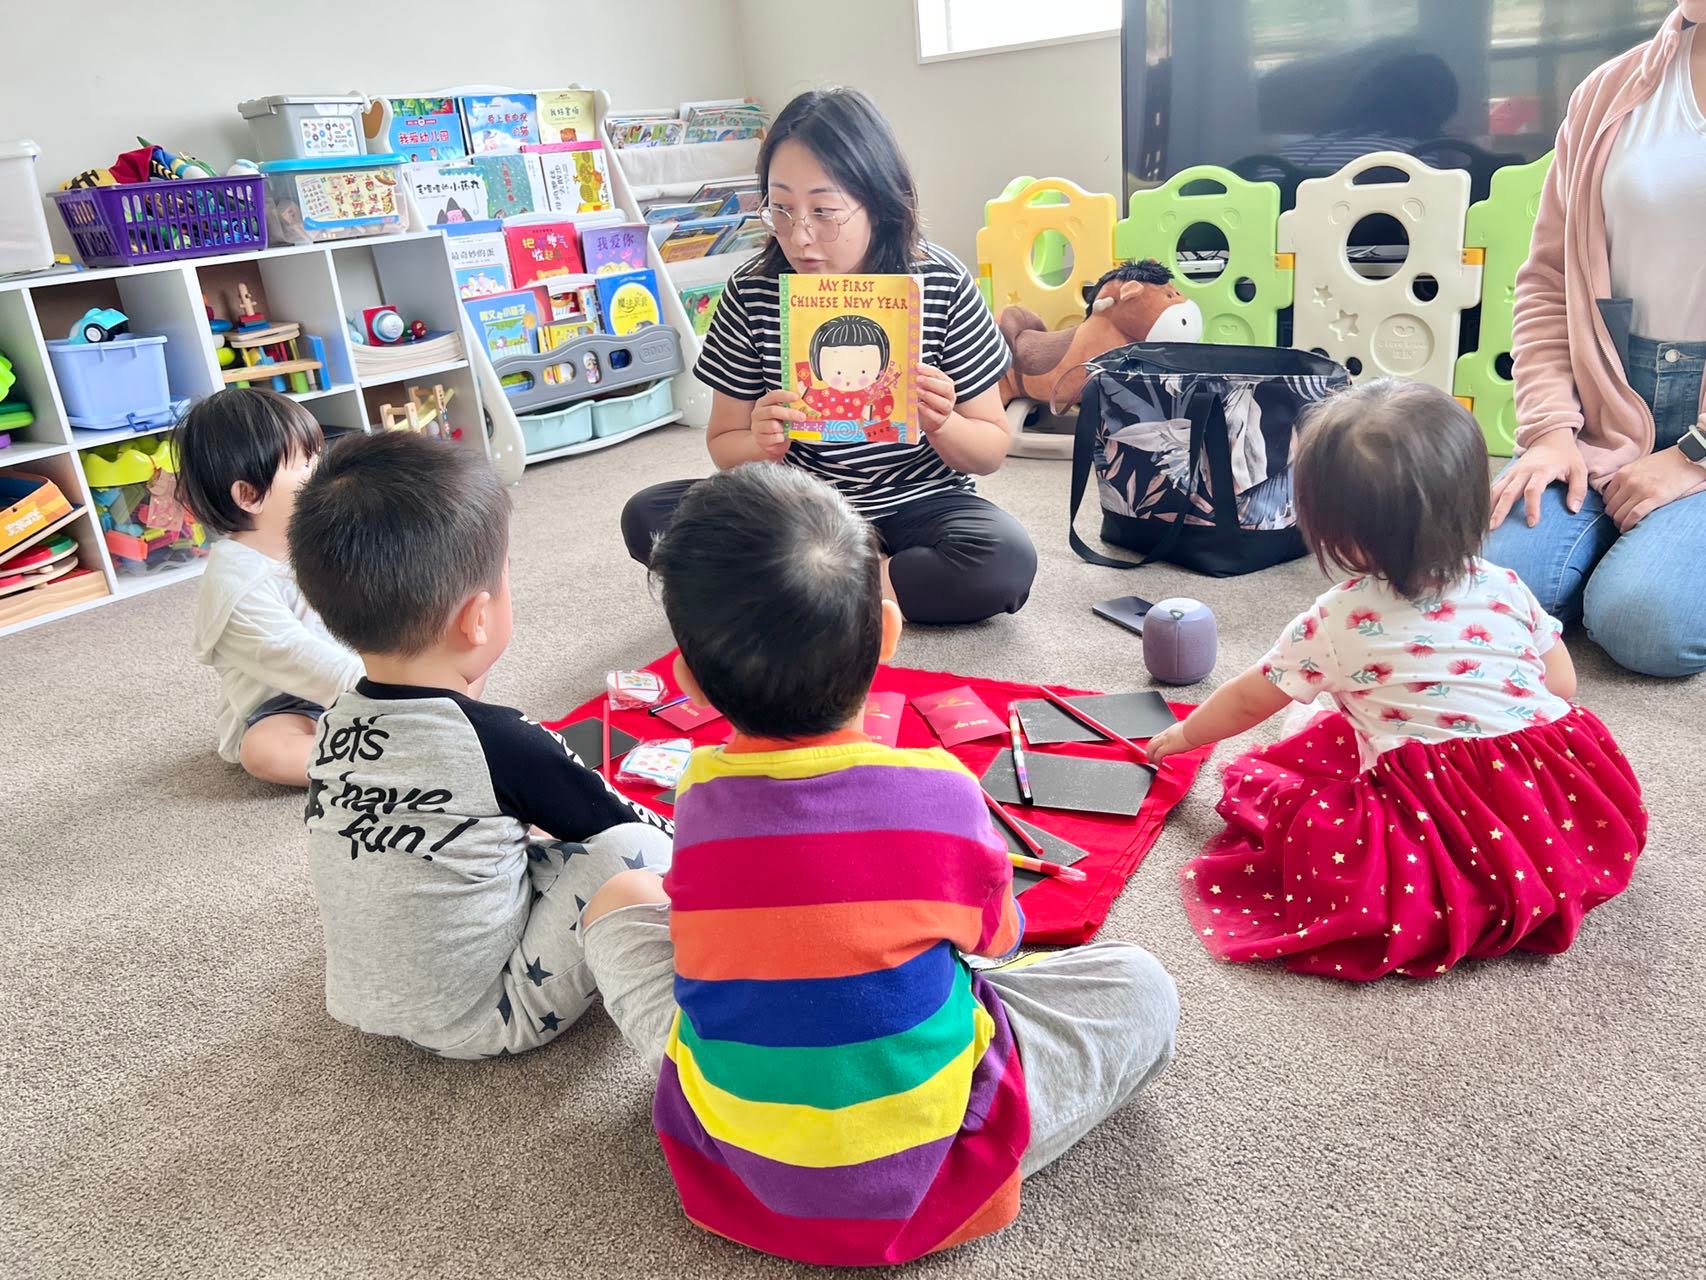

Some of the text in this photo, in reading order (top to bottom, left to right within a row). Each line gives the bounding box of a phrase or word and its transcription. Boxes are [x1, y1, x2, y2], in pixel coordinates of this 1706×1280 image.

[398, 129, 449, 145] 我爱幼儿园
[597, 233, 635, 251] 我爱你
[817, 278, 875, 293] MY FIRST
[790, 294, 908, 310] CHINESE NEW YEAR
[330, 771, 453, 815] have
[338, 812, 480, 861] fun!
